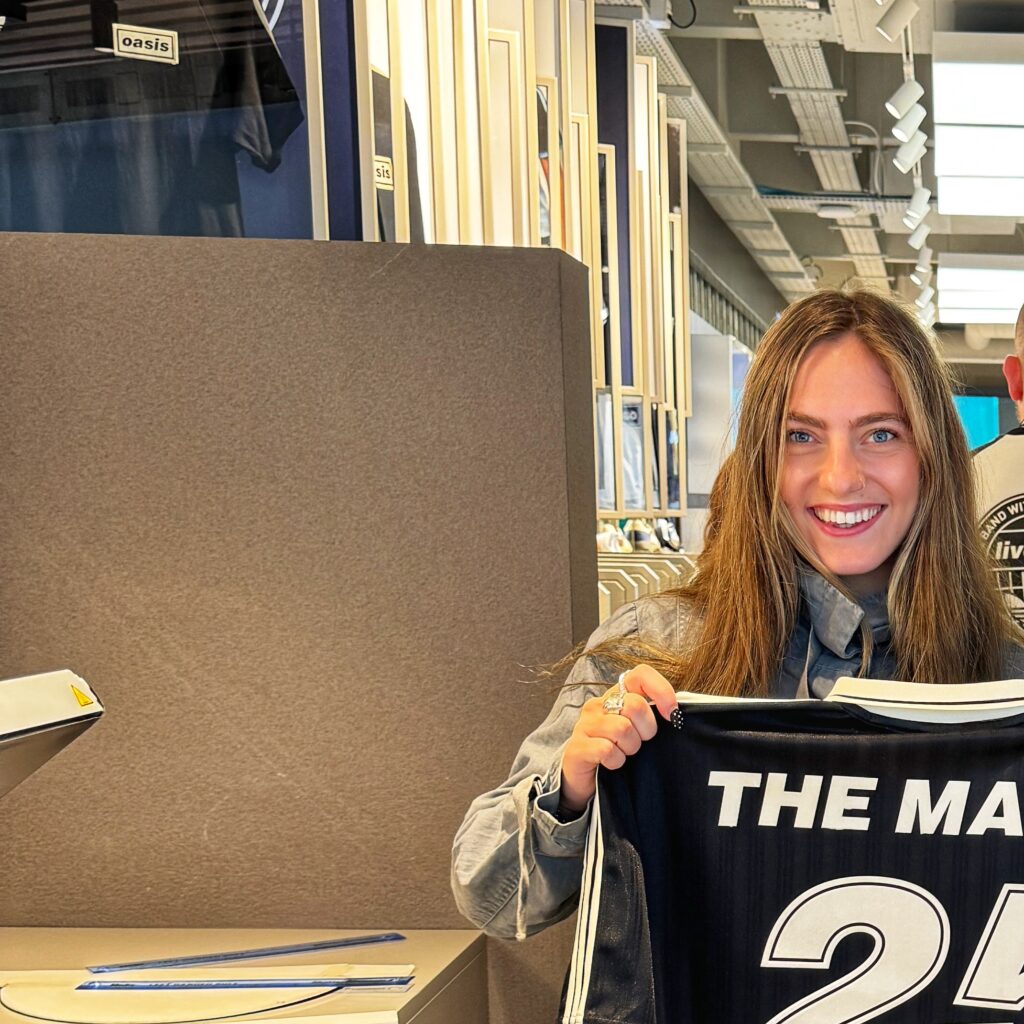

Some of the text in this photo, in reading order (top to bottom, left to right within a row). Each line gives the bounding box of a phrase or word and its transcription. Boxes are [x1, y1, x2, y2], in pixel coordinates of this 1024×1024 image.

[122, 36, 169, 52] oasis
[376, 165, 391, 179] sis
[980, 510, 1007, 541] BAND
[708, 770, 878, 831] THE
